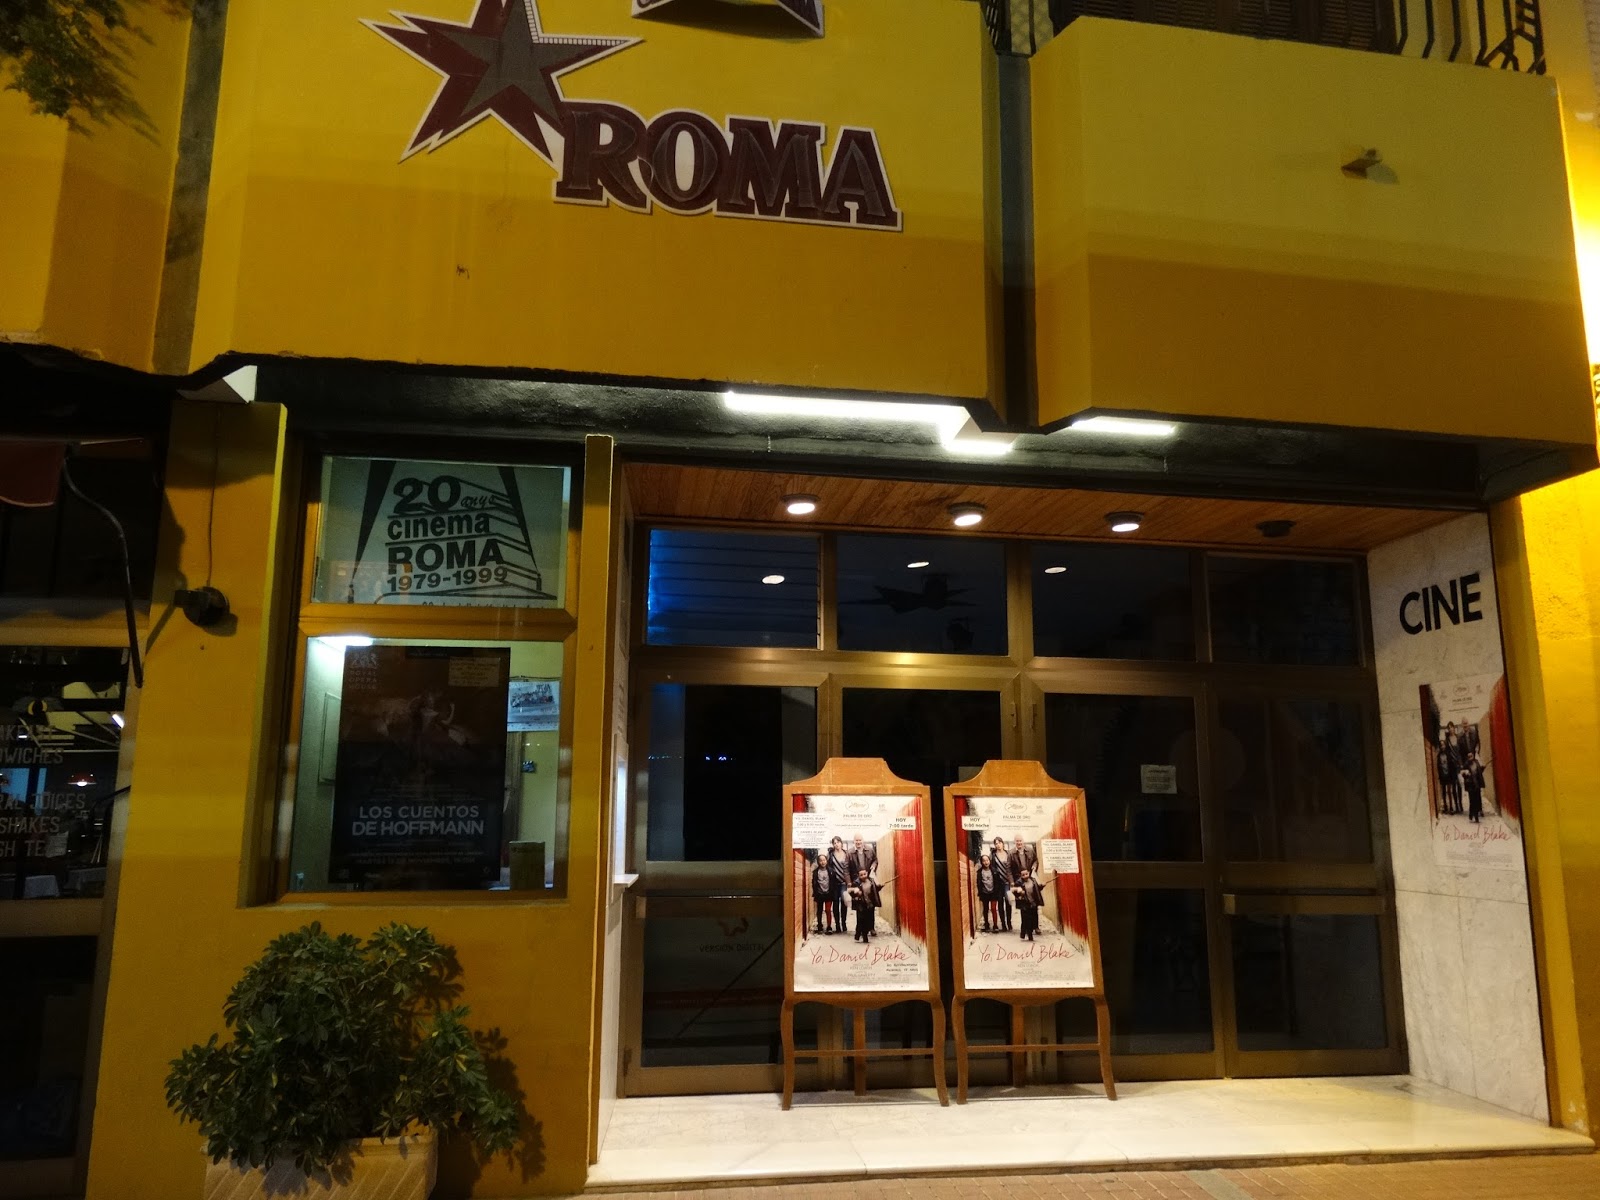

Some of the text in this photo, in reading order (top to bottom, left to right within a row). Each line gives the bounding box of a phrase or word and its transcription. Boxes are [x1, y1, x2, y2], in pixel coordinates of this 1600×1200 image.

[554, 101, 901, 230] ROMA
[393, 475, 461, 515] 20
[387, 512, 490, 541] cinema
[388, 538, 504, 576] ROMA
[387, 566, 508, 593] 1979-1999
[1400, 572, 1483, 635] CINE
[359, 805, 480, 819] LOS CUENTOS
[352, 819, 485, 837] DE HOFFMANN
[828, 944, 870, 963] Daniel
[871, 945, 911, 966] Blake
[996, 943, 1036, 961] Daniel
[1037, 943, 1074, 964] Blake
